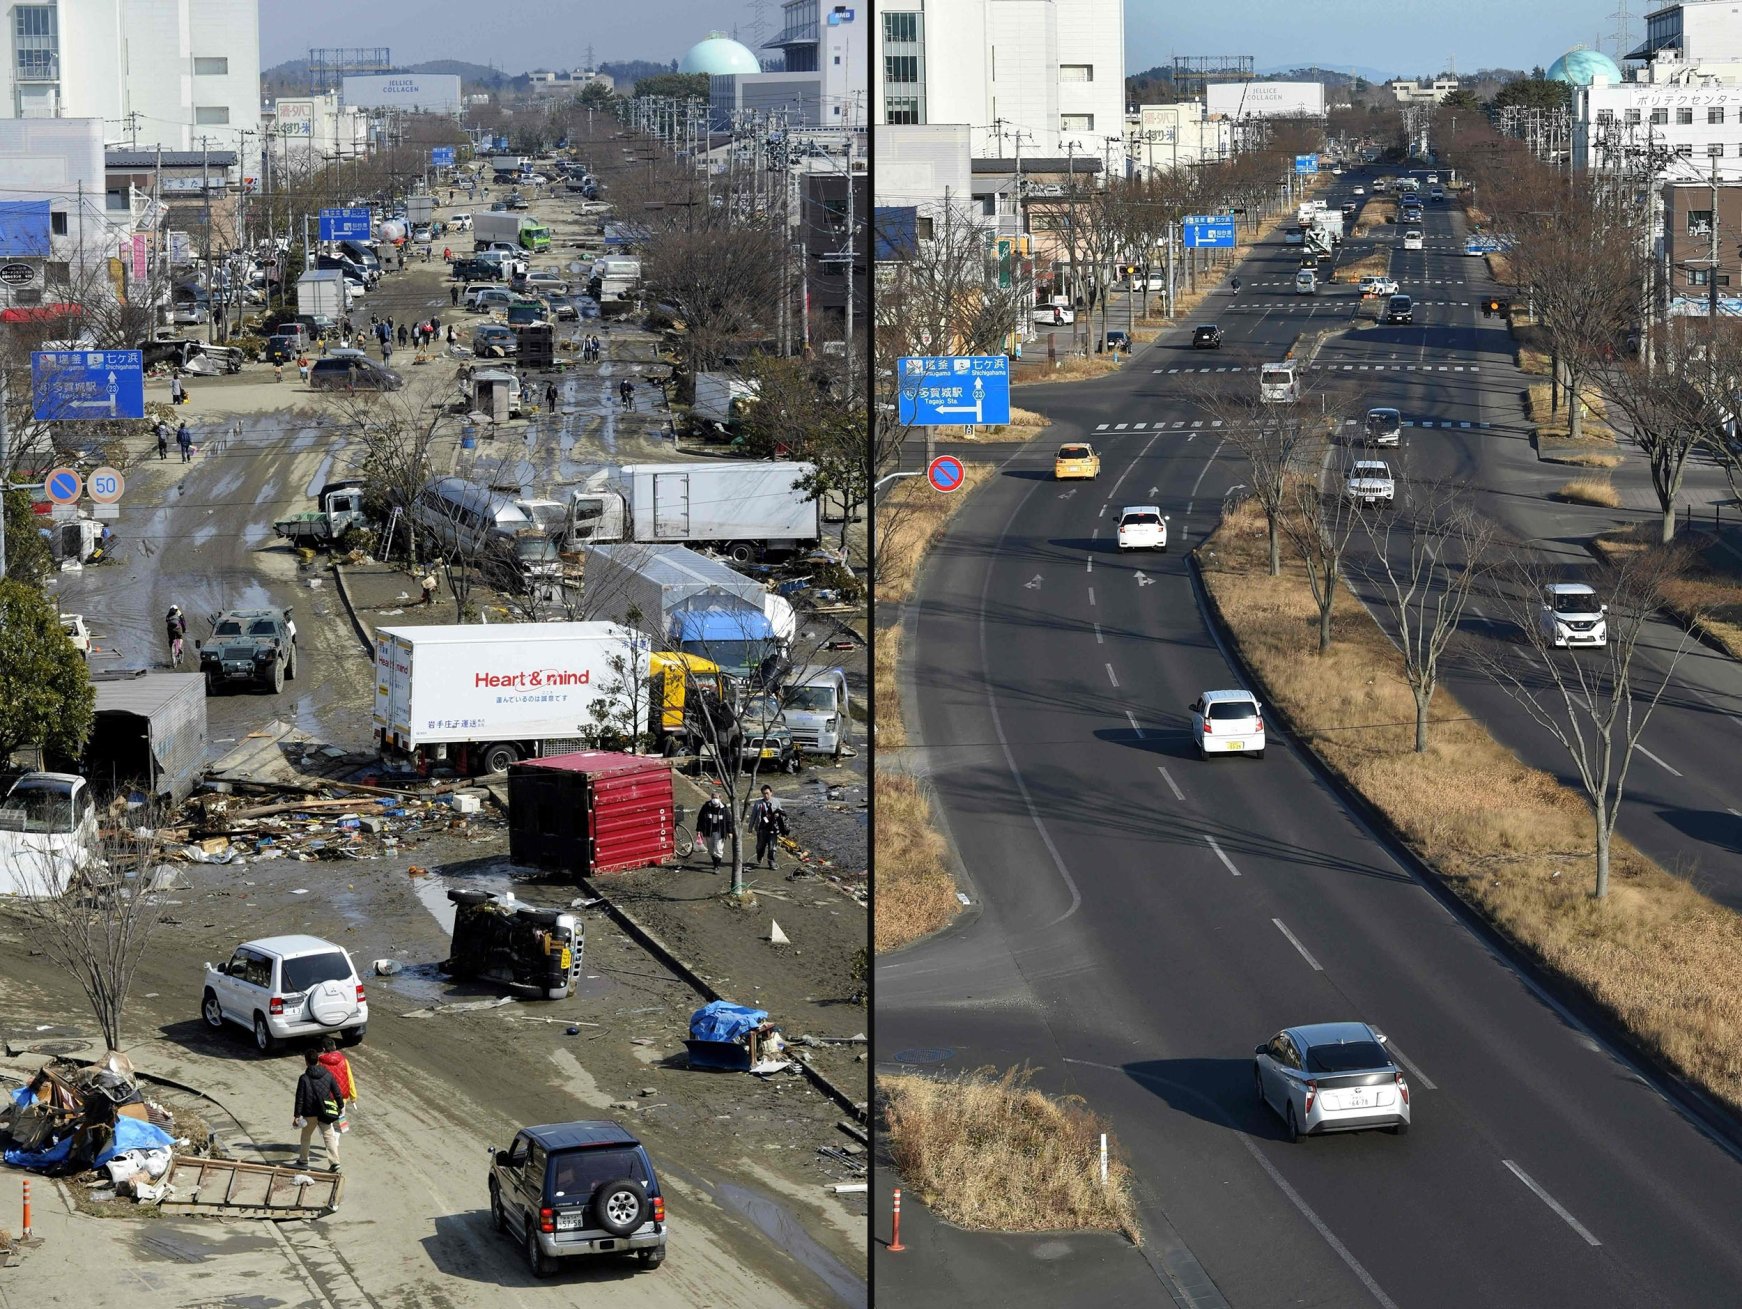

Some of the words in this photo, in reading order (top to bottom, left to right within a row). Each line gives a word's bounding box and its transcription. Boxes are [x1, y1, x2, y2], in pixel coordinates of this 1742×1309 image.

[919, 387, 963, 398] 多賀城駅
[975, 390, 983, 398] 23
[96, 477, 116, 494] 50
[475, 671, 526, 688] Heart
[529, 671, 542, 686] &
[547, 669, 590, 685] mind
